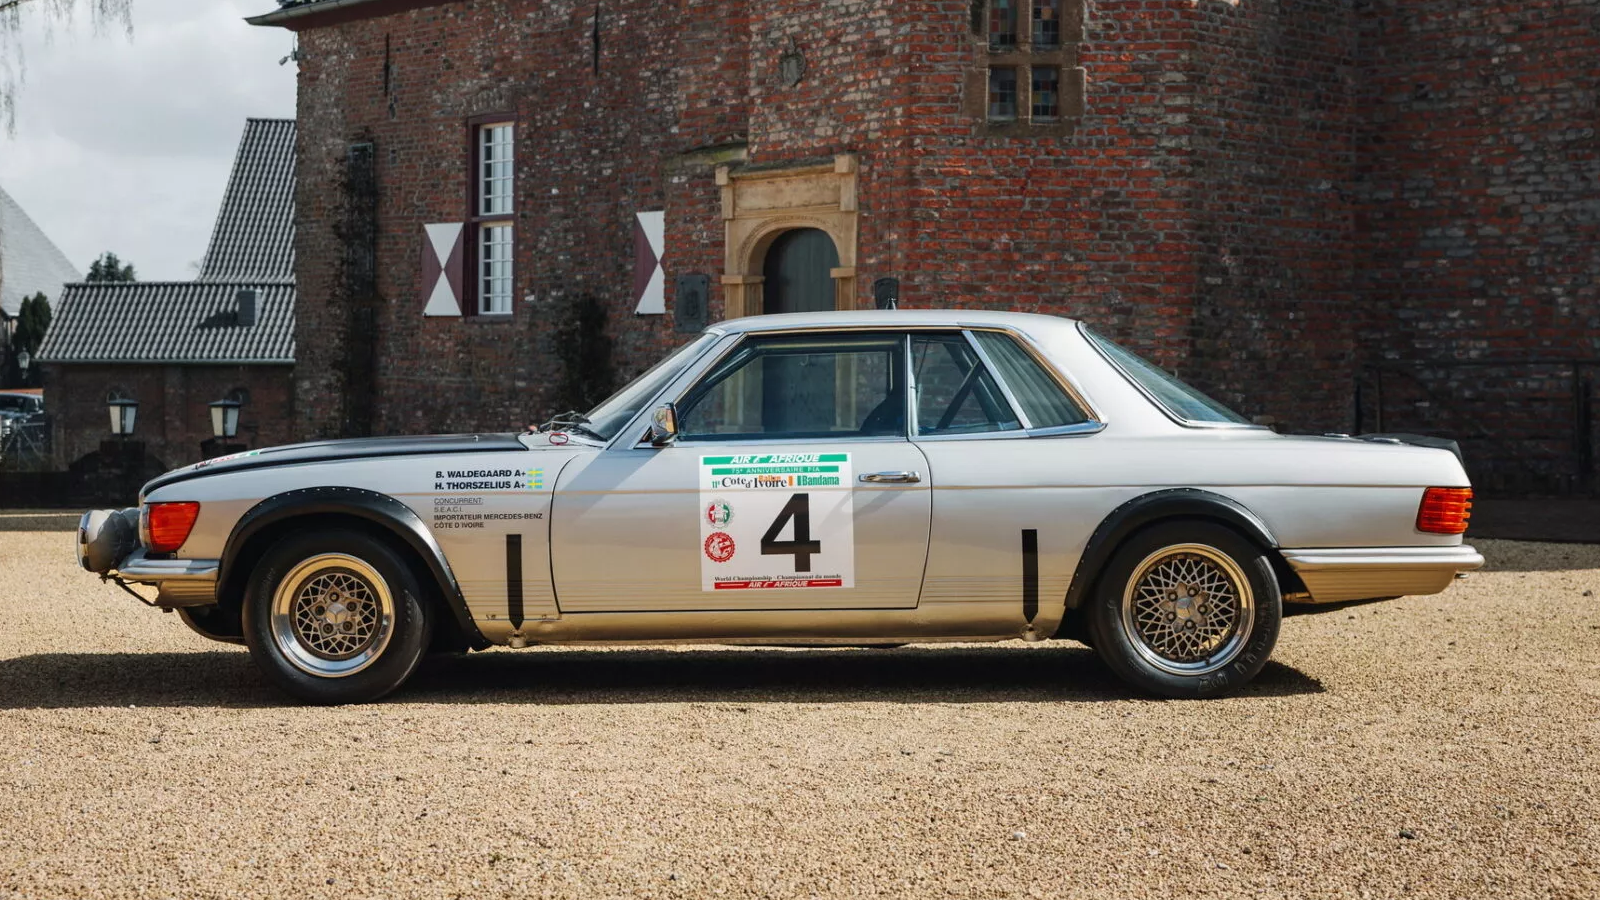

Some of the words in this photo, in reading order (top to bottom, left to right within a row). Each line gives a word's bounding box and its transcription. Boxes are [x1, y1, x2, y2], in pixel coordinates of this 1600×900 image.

[730, 456, 750, 464] AIR
[768, 454, 821, 463] AFRIQUE
[435, 471, 445, 479] B.
[447, 469, 512, 478] WALDEGAARD
[514, 469, 526, 477] A+
[746, 466, 804, 474] ANNIVERSAIRE
[435, 482, 445, 490] H.
[446, 481, 511, 490] THORSZELIUS
[513, 481, 526, 489] A+
[760, 493, 821, 573] 4
[774, 580, 809, 588] AFRIQUE
